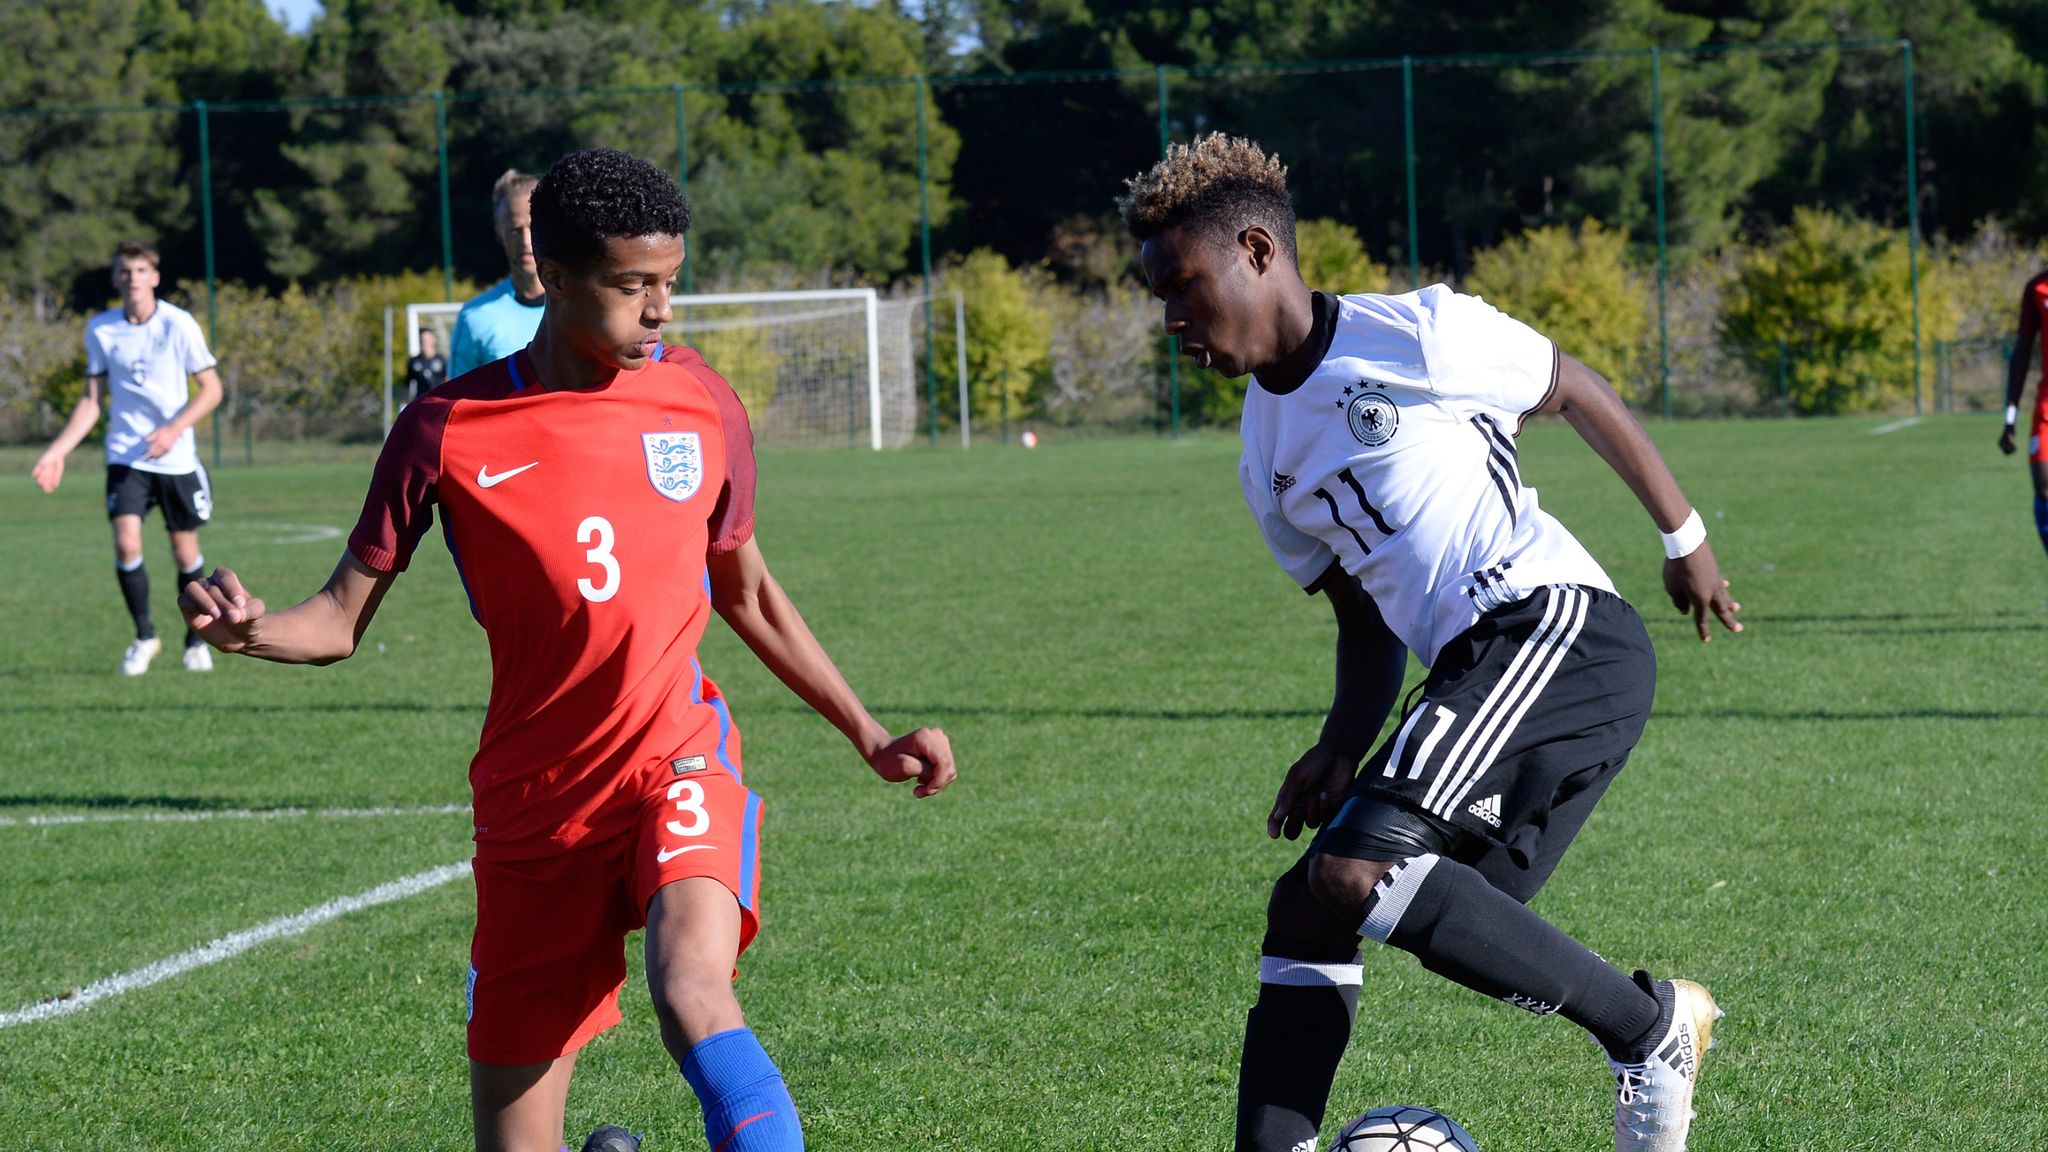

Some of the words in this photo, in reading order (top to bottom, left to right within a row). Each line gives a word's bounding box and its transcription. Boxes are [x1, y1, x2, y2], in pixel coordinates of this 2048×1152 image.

[1313, 467, 1397, 556] 11
[577, 516, 620, 602] 3
[1383, 702, 1457, 779] 11
[666, 780, 710, 836] 3
[1468, 803, 1501, 828] adidas
[1679, 1022, 1693, 1081] adidas
